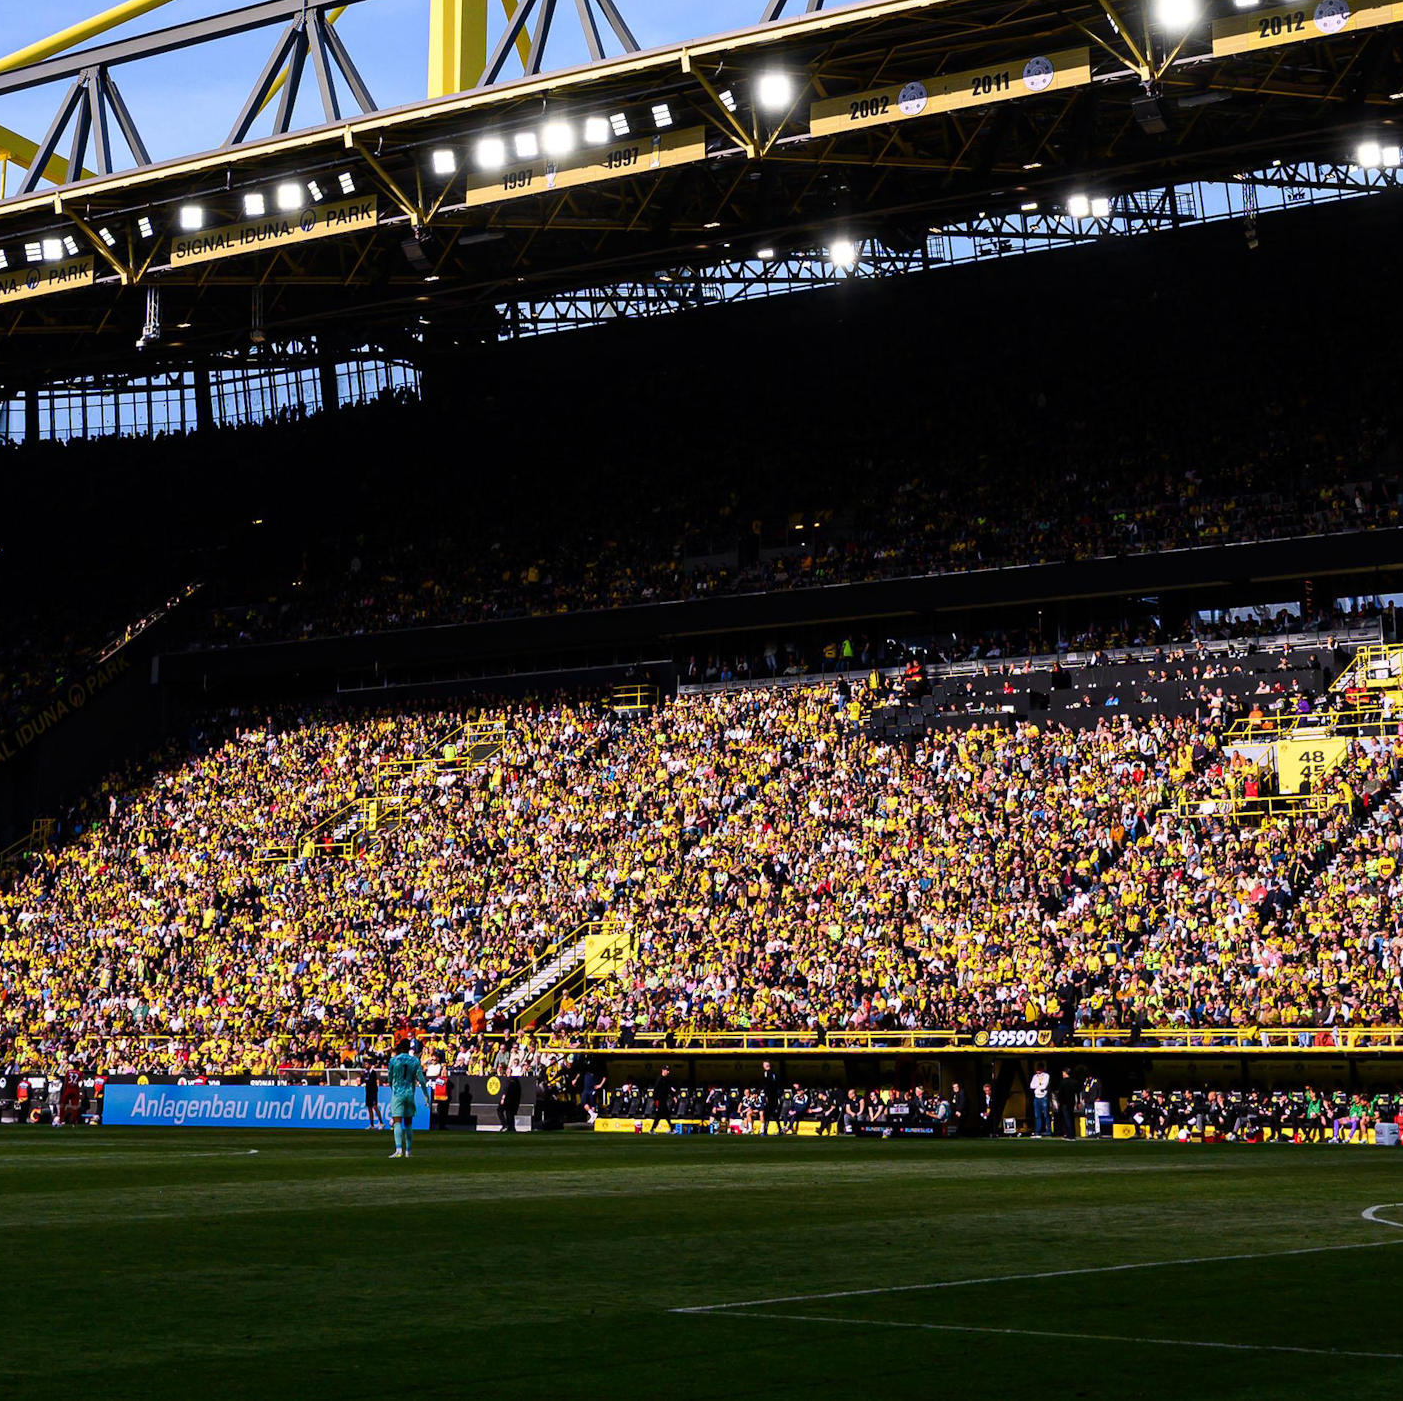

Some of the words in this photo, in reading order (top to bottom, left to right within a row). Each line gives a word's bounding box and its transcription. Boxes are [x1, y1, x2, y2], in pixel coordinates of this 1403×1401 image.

[1259, 11, 1305, 39] 2012
[850, 96, 889, 120] 2002
[971, 72, 1009, 96] 2011
[502, 169, 533, 190] 1997
[607, 147, 639, 169] 1997
[176, 232, 237, 258] SIGNAL
[240, 221, 290, 245] IDUNA
[326, 203, 372, 227] PARK
[48, 265, 89, 285] PARK
[14, 700, 69, 748] IDUNA
[85, 655, 130, 695] PARK
[1299, 751, 1325, 762] 48
[1299, 764, 1324, 776] 45
[600, 947, 624, 961] 42
[988, 1029, 1037, 1046] 59590
[68, 1073, 79, 1085] 32
[131, 1092, 250, 1124] Anlagenbau
[255, 1094, 293, 1119] und
